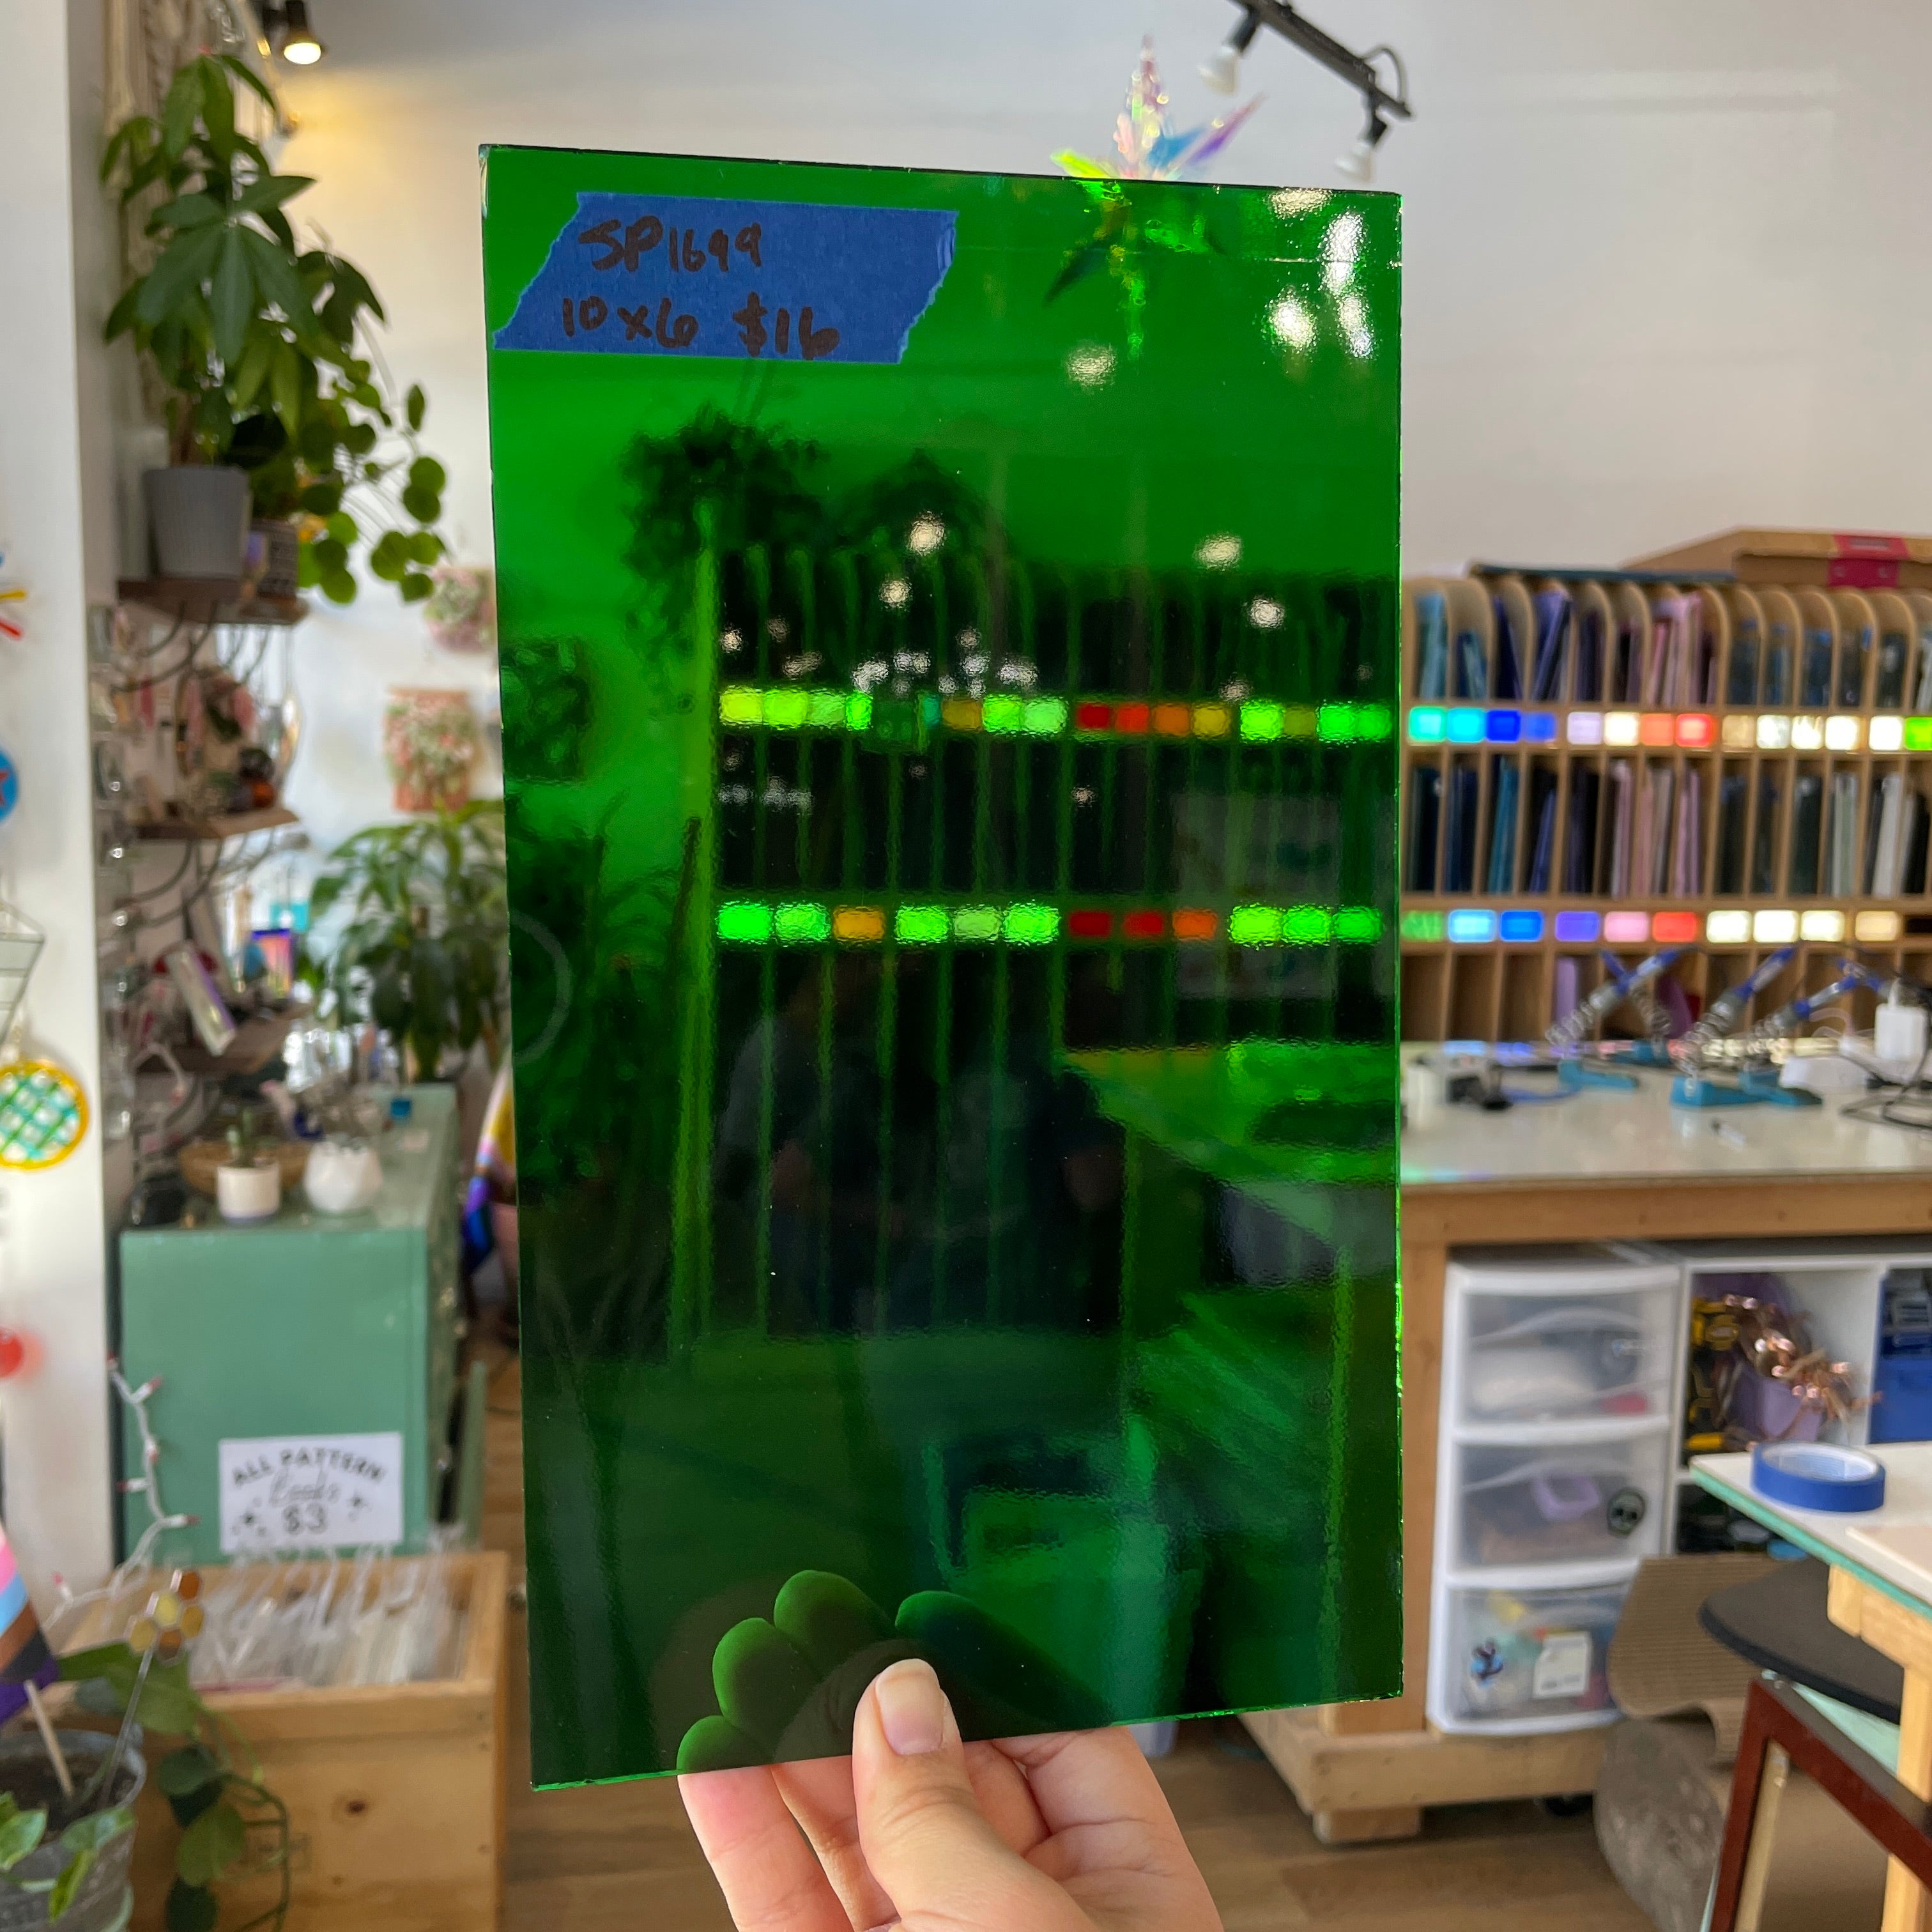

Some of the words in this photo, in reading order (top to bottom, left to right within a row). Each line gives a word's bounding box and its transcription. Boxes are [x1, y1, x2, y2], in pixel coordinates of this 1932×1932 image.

[578, 215, 762, 272] SP1699
[733, 291, 839, 360] $16
[232, 1455, 272, 1489] ALL
[280, 1446, 386, 1483] PATTERN
[283, 1503, 328, 1535] $3
